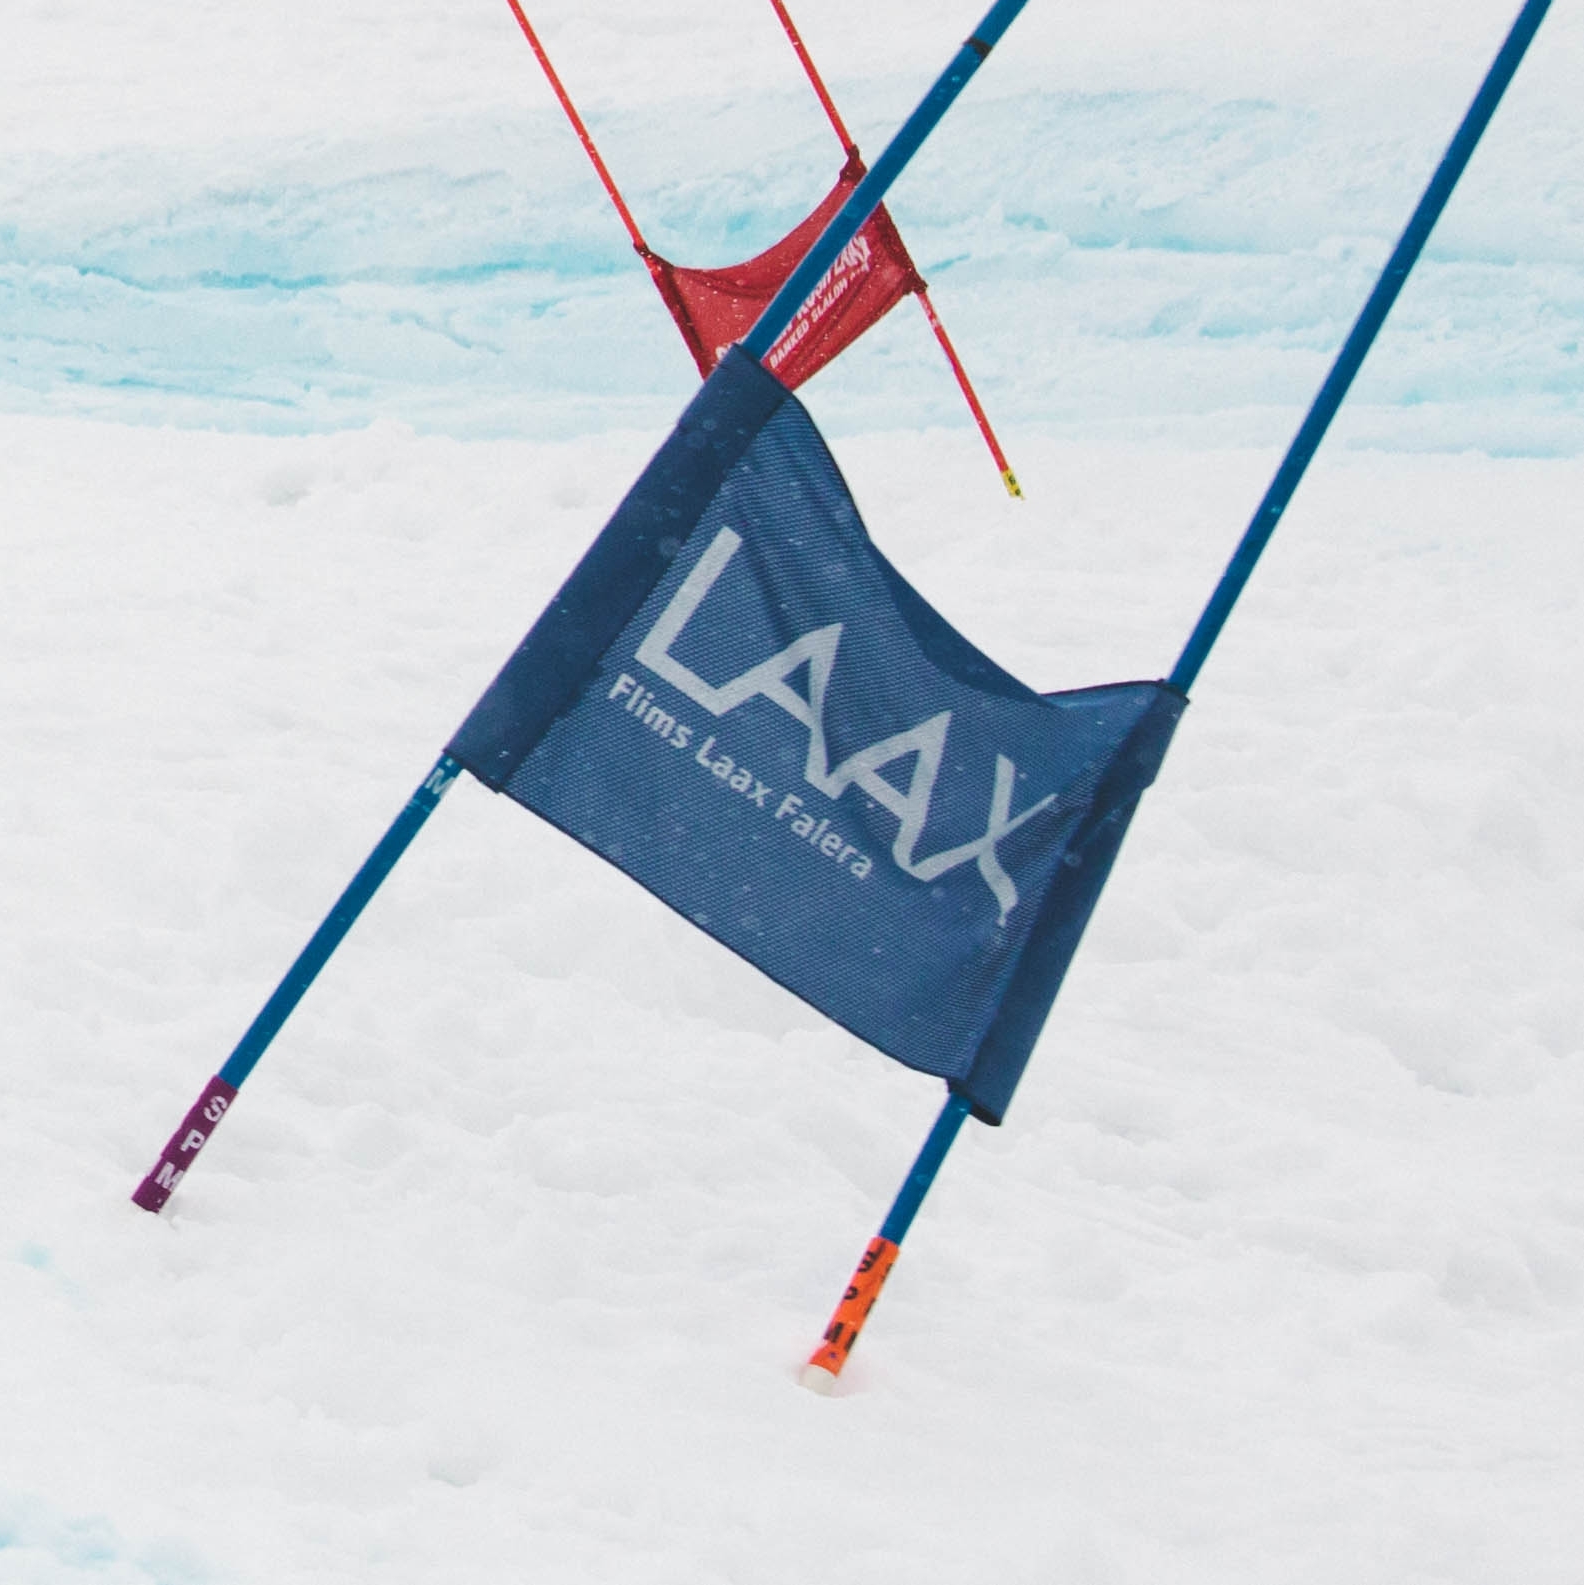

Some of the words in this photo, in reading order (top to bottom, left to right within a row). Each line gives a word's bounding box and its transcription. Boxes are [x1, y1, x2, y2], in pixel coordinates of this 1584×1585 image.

[769, 321, 810, 368] BANKED
[811, 278, 848, 322] SLALOM
[608, 673, 694, 749] Flims
[695, 736, 774, 808] Laax
[774, 793, 873, 879] Falera
[634, 526, 1057, 926] LAAX
